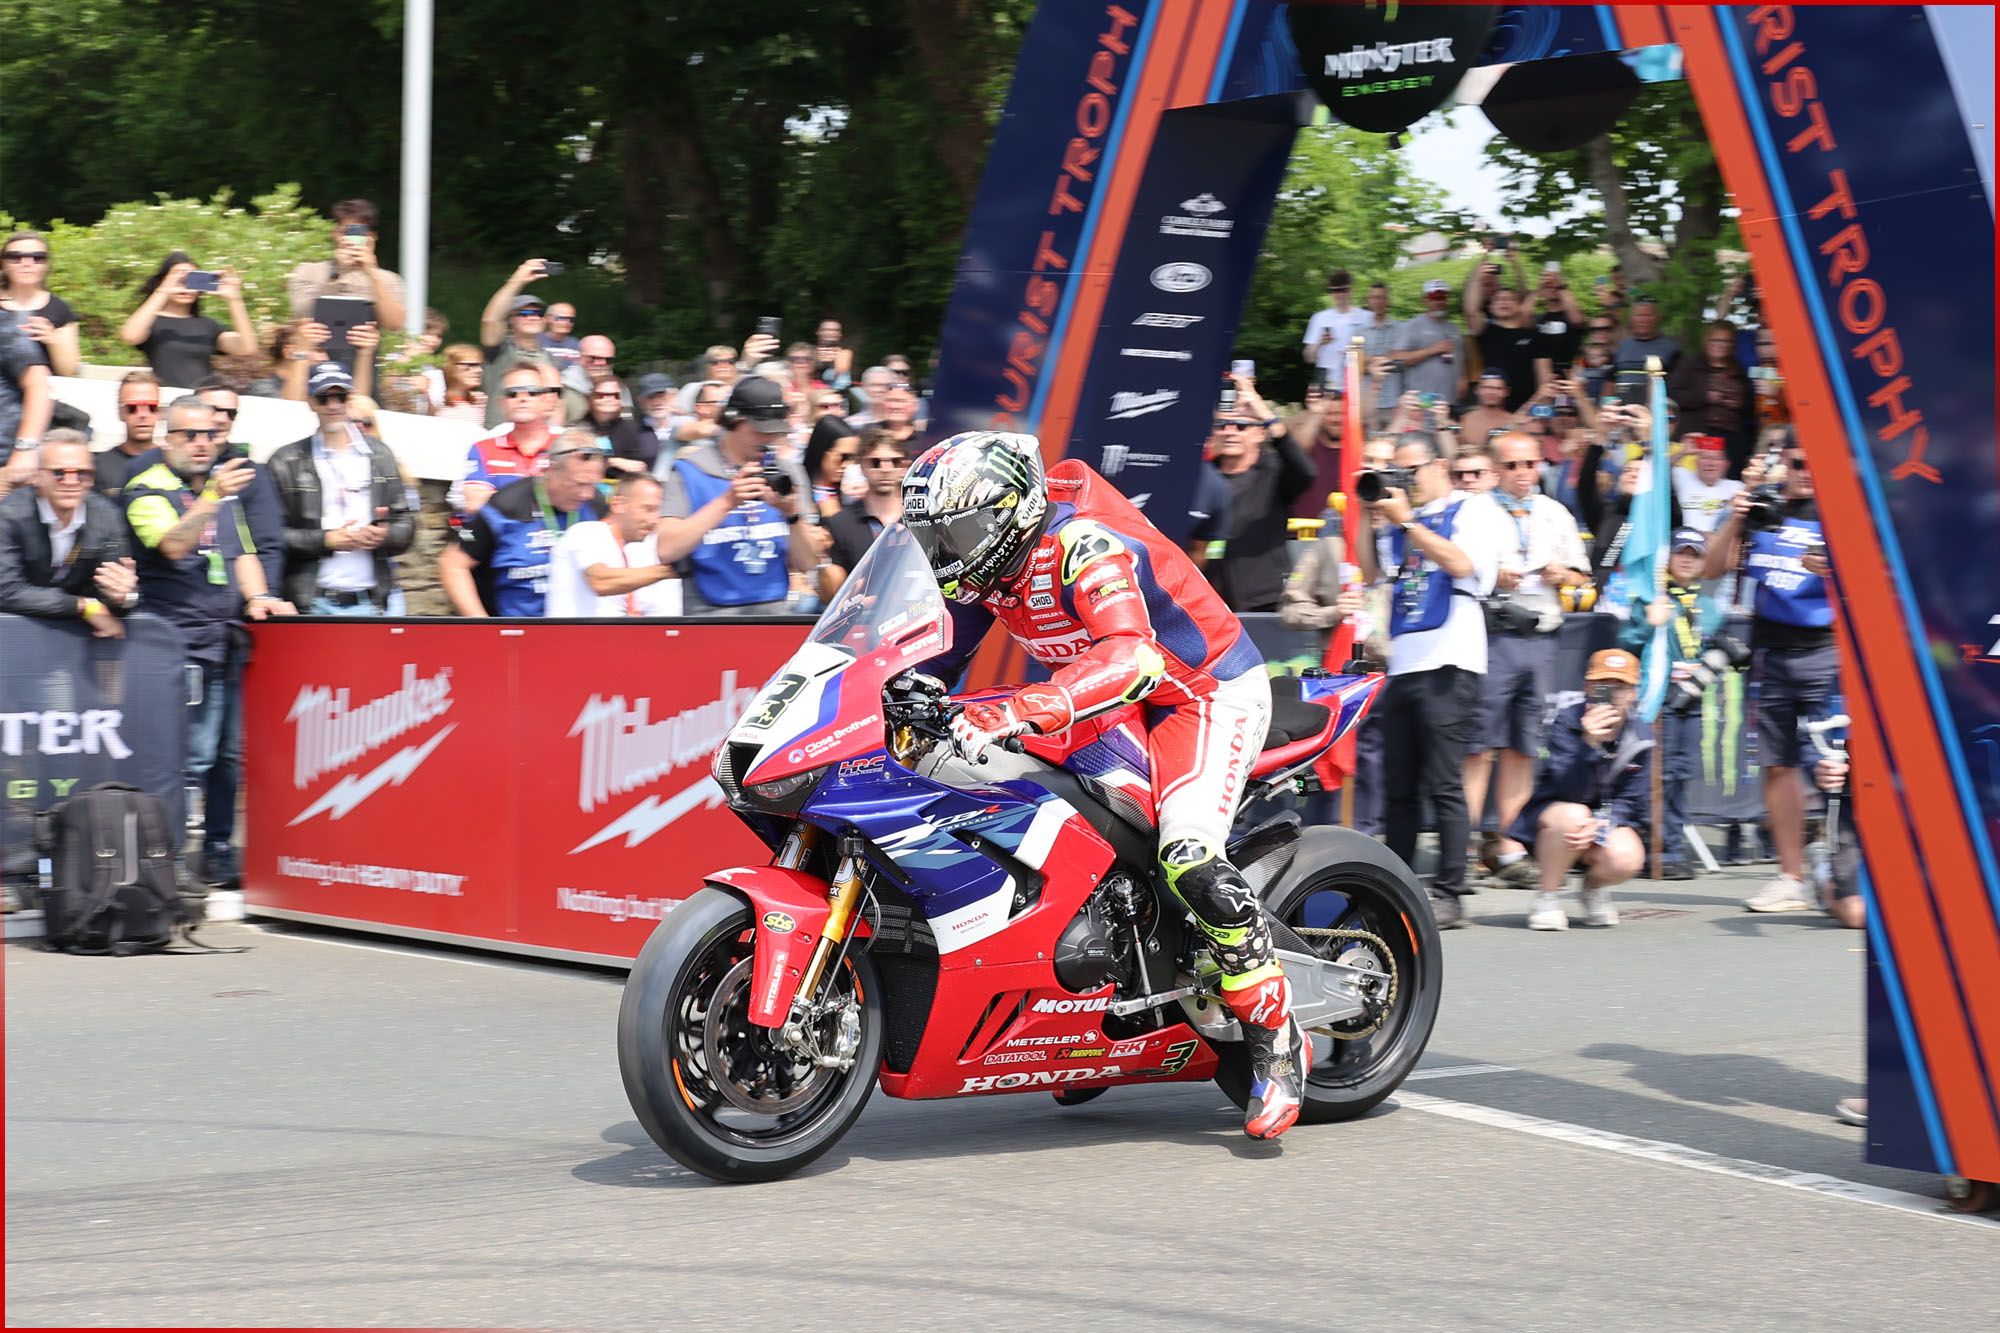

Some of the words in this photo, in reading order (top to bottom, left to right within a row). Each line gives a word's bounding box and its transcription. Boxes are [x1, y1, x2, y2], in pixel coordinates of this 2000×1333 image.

[1808, 169, 1943, 484] TROPHY
[1021, 493, 1041, 523] SHOEI
[979, 528, 1019, 575] MONSTER
[1031, 595, 1053, 607] SHOEI
[742, 673, 812, 729] 3
[804, 736, 834, 753] Close
[834, 713, 879, 740] Brothers
[839, 755, 886, 775] HRC
[1218, 716, 1248, 815] HONDA
[766, 912, 793, 930] sbs
[951, 912, 989, 931] HONDA
[1031, 998, 1109, 1014] MOTUL
[1006, 1035, 1081, 1047] METZELER
[1112, 1041, 1145, 1055] RK
[984, 1050, 1048, 1066] DATATOOL
[1146, 1039, 1199, 1077] 3
[957, 1065, 1123, 1094] HONDA
